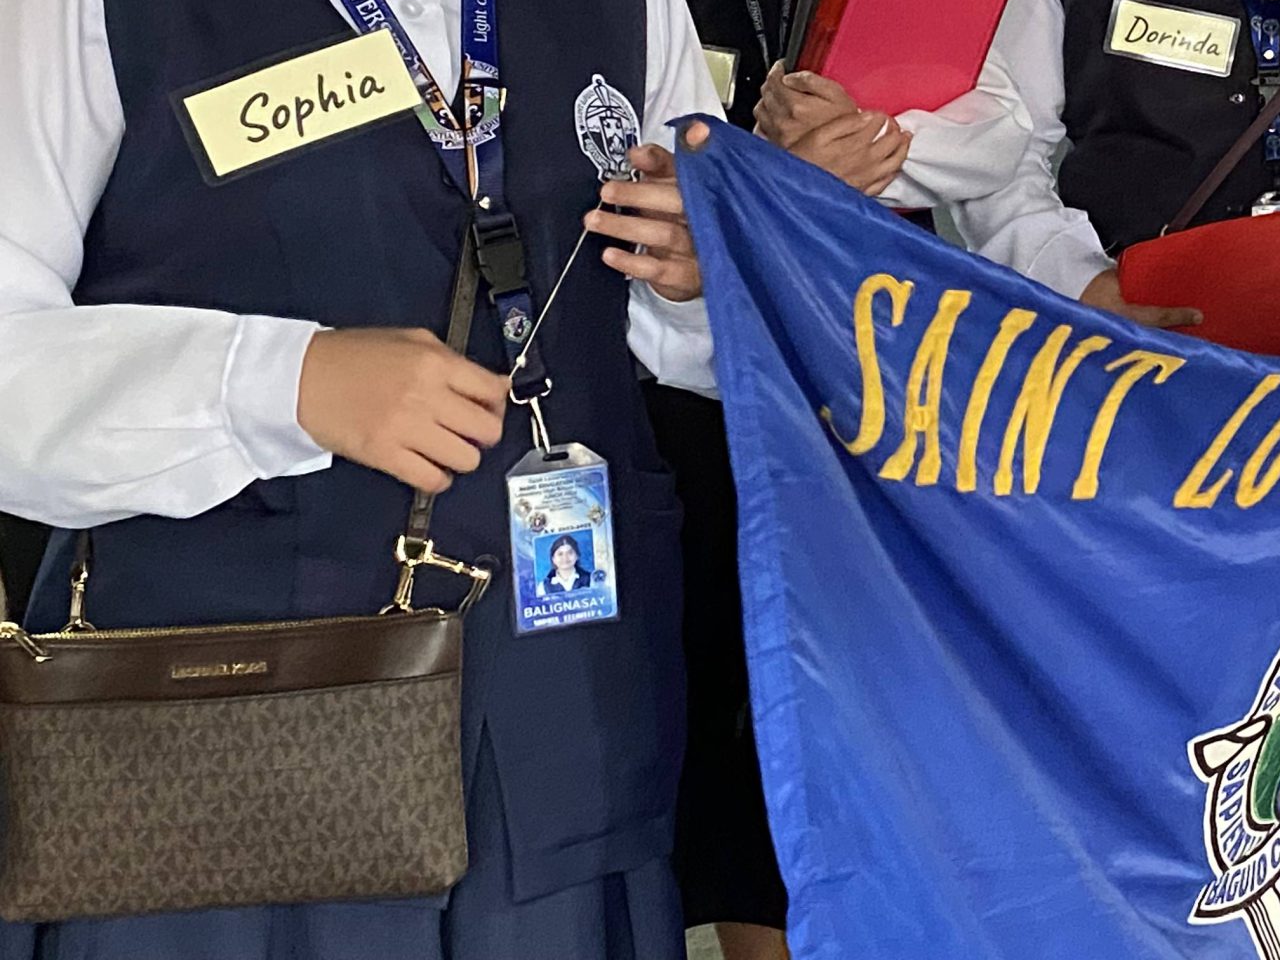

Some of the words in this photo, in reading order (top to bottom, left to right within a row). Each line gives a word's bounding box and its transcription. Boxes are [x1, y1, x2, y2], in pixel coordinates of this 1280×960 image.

[474, 8, 491, 43] Light
[1124, 15, 1221, 56] Dorinda
[239, 71, 385, 143] Sophia
[822, 274, 1186, 500] SAINT
[523, 596, 606, 619] BALIGNASAY
[1204, 855, 1268, 907] BAGUIO
